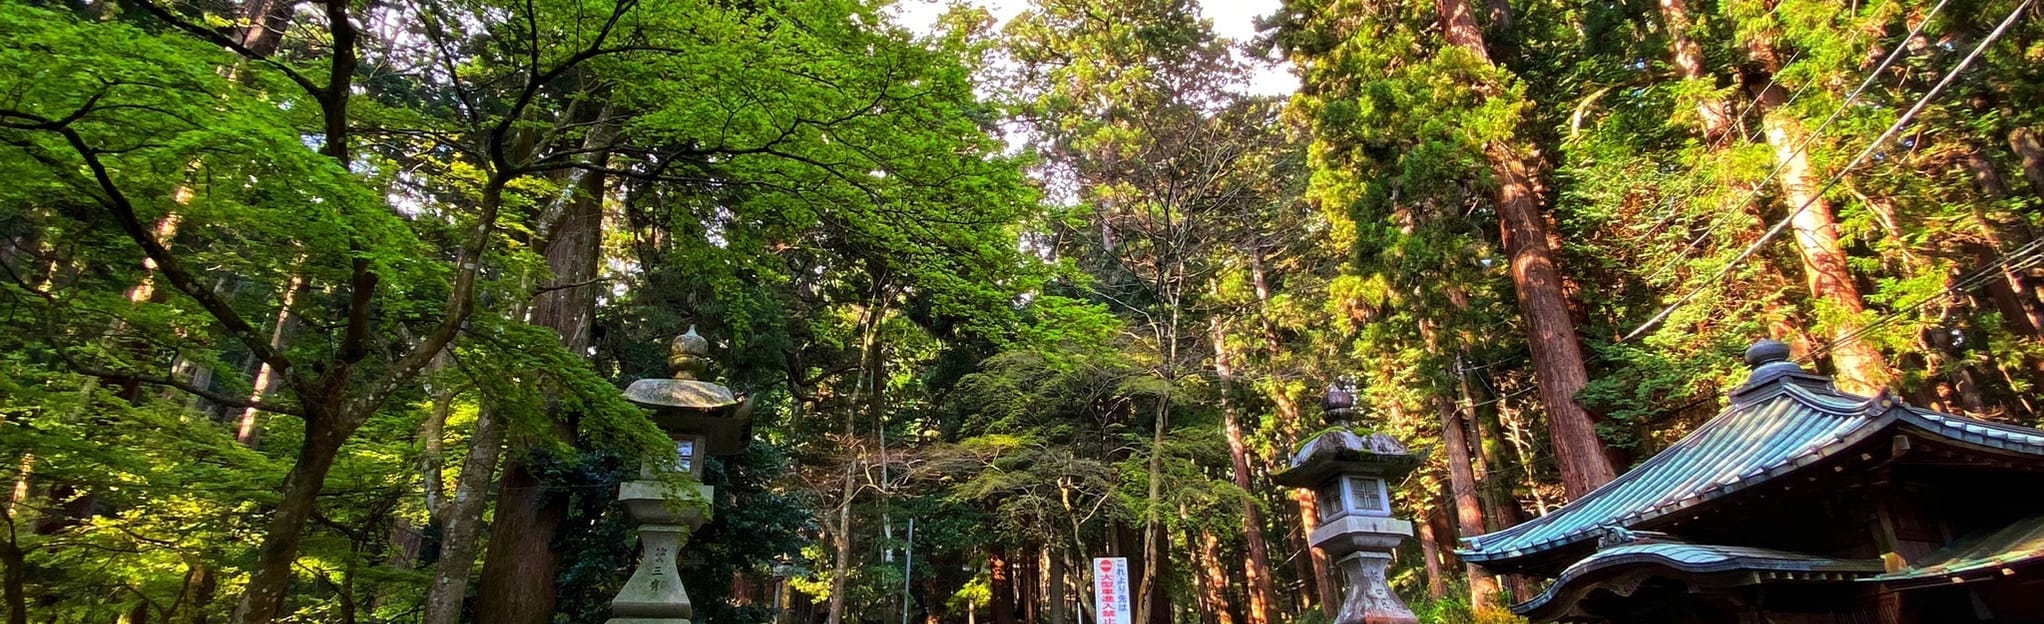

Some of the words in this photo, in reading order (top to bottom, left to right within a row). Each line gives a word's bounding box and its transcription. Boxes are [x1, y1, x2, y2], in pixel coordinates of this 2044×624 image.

[1100, 574, 1115, 624] 大型車進入禁止
[1116, 560, 1127, 612] これより先は
